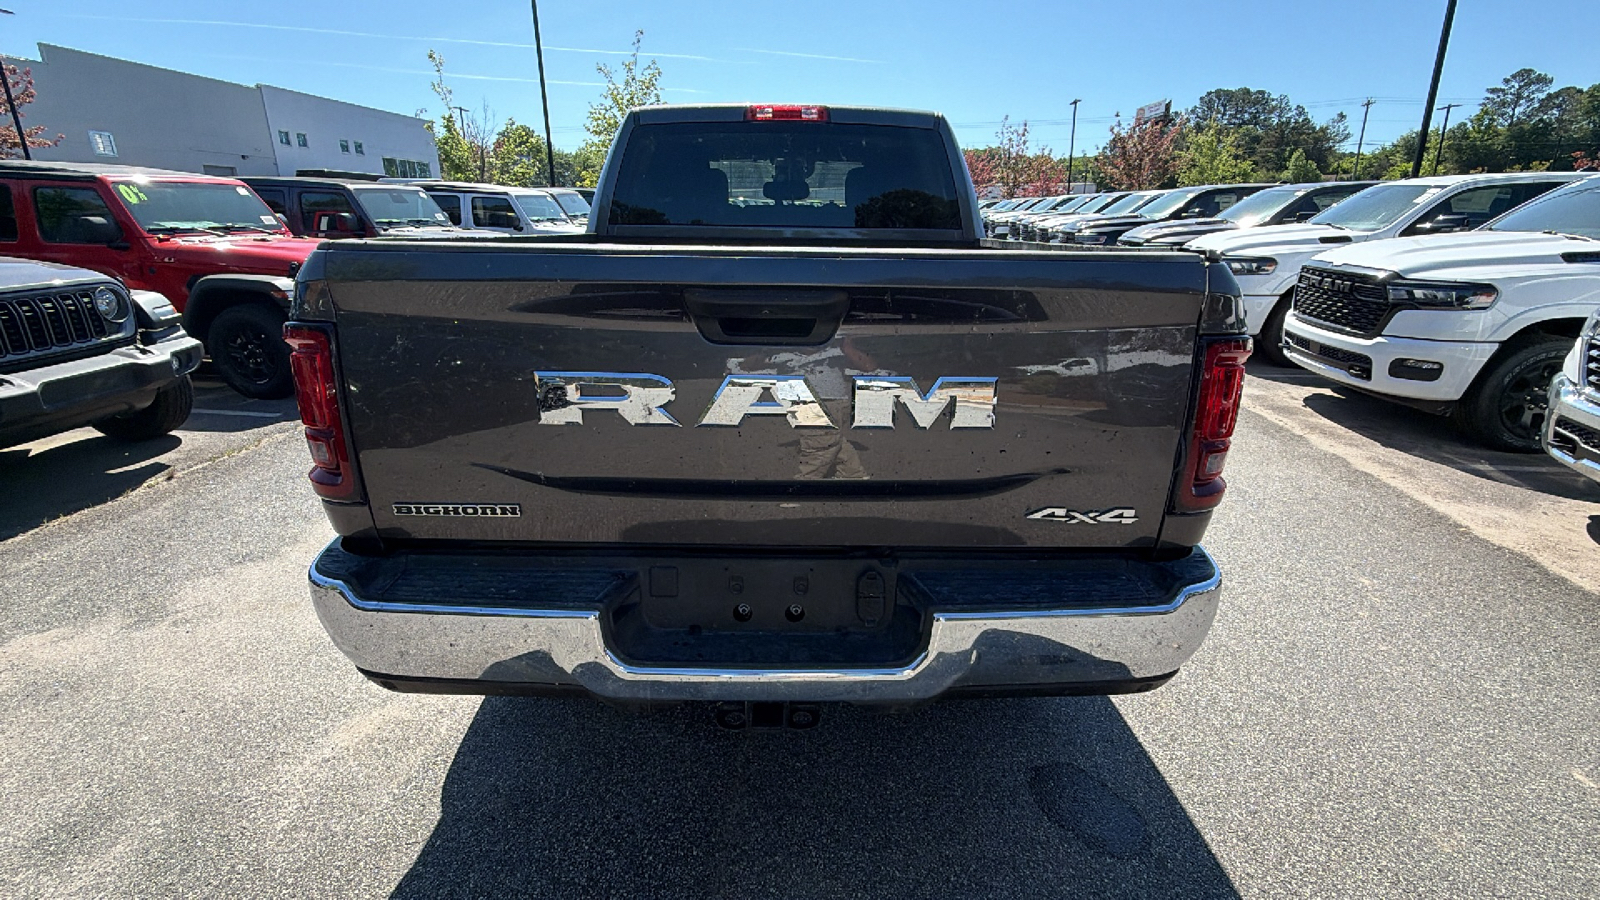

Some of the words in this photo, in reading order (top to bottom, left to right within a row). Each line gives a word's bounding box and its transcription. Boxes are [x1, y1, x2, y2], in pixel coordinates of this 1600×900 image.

[118, 184, 148, 204] 0%
[1309, 276, 1352, 293] RAM
[533, 371, 999, 430] RAM
[392, 502, 521, 518] BIGHORN
[1026, 506, 1139, 525] 4x4
